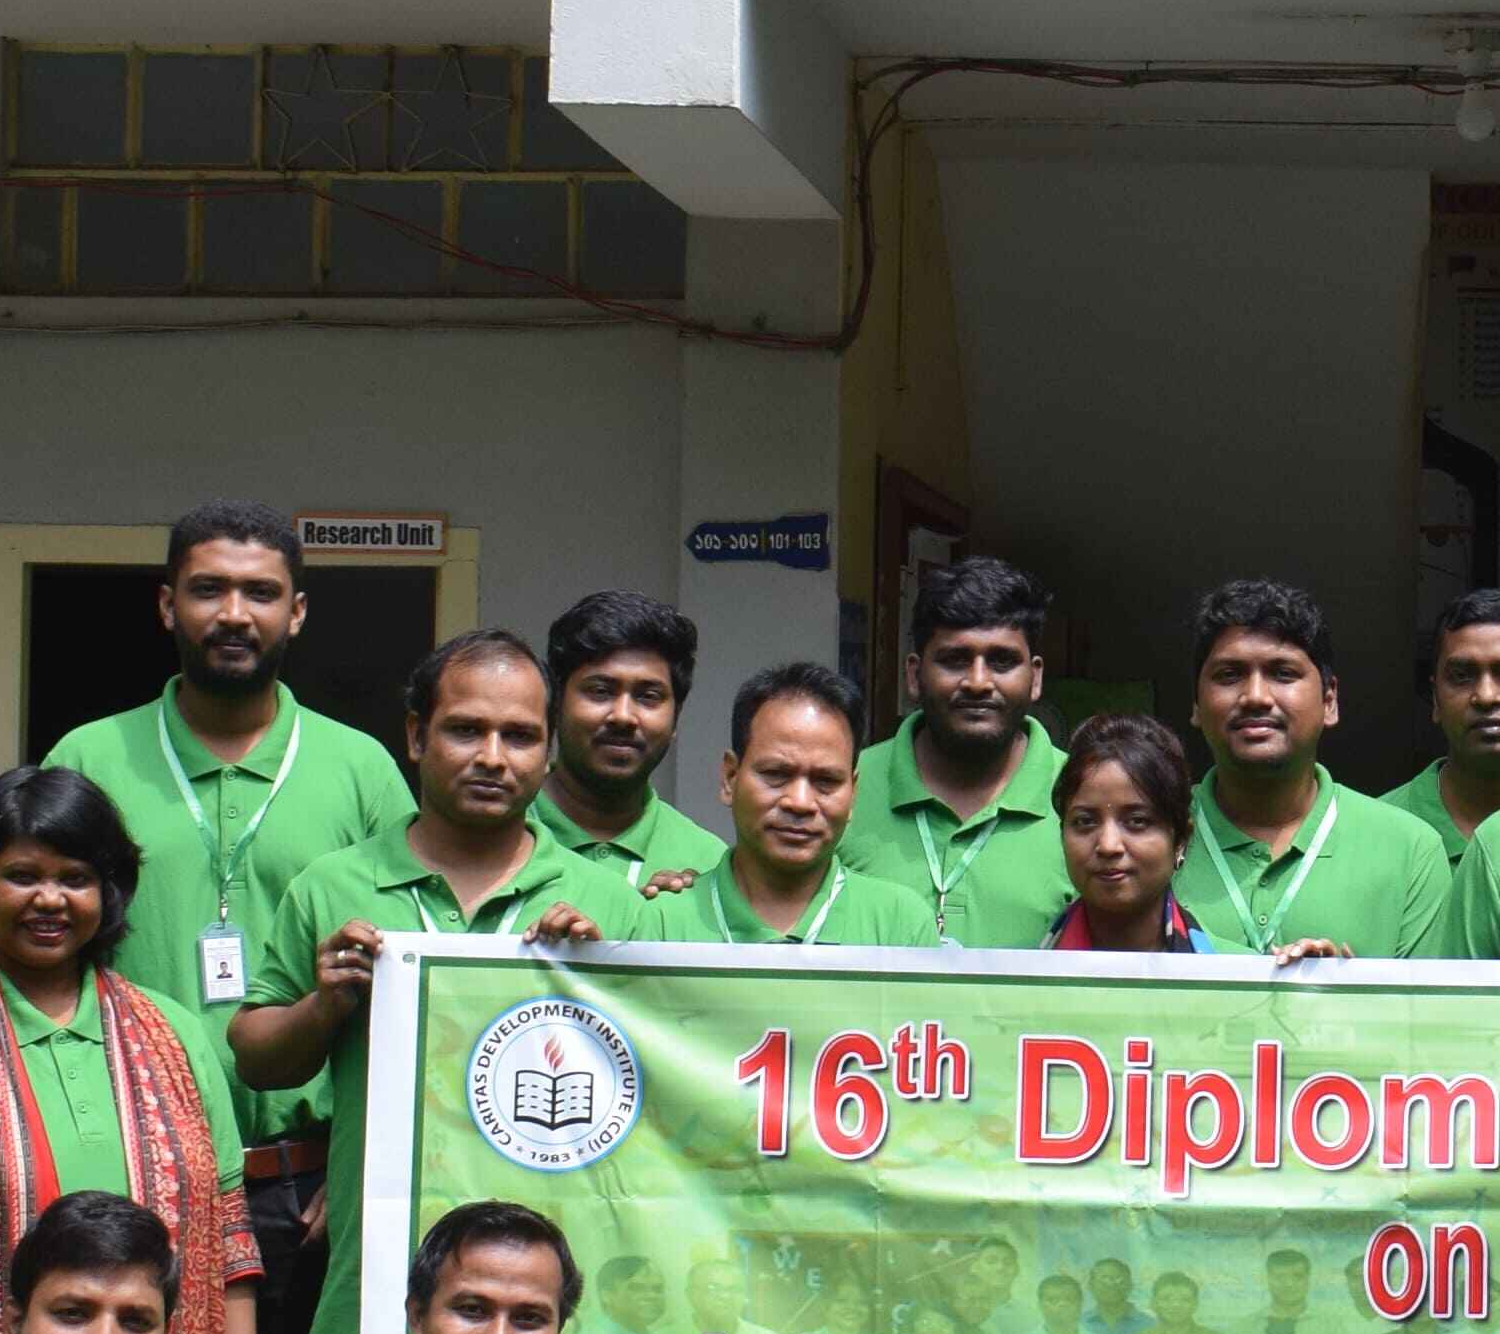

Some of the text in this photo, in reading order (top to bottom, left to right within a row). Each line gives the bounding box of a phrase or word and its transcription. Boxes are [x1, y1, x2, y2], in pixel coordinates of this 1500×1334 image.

[303, 520, 435, 547] Research Unit
[474, 1004, 636, 1153] CARITAS DEVELOPMENT INSTITUTE (CDI)
[739, 1020, 970, 1159] 16th
[530, 1151, 571, 1163] 1983
[1364, 1220, 1487, 1319] on
